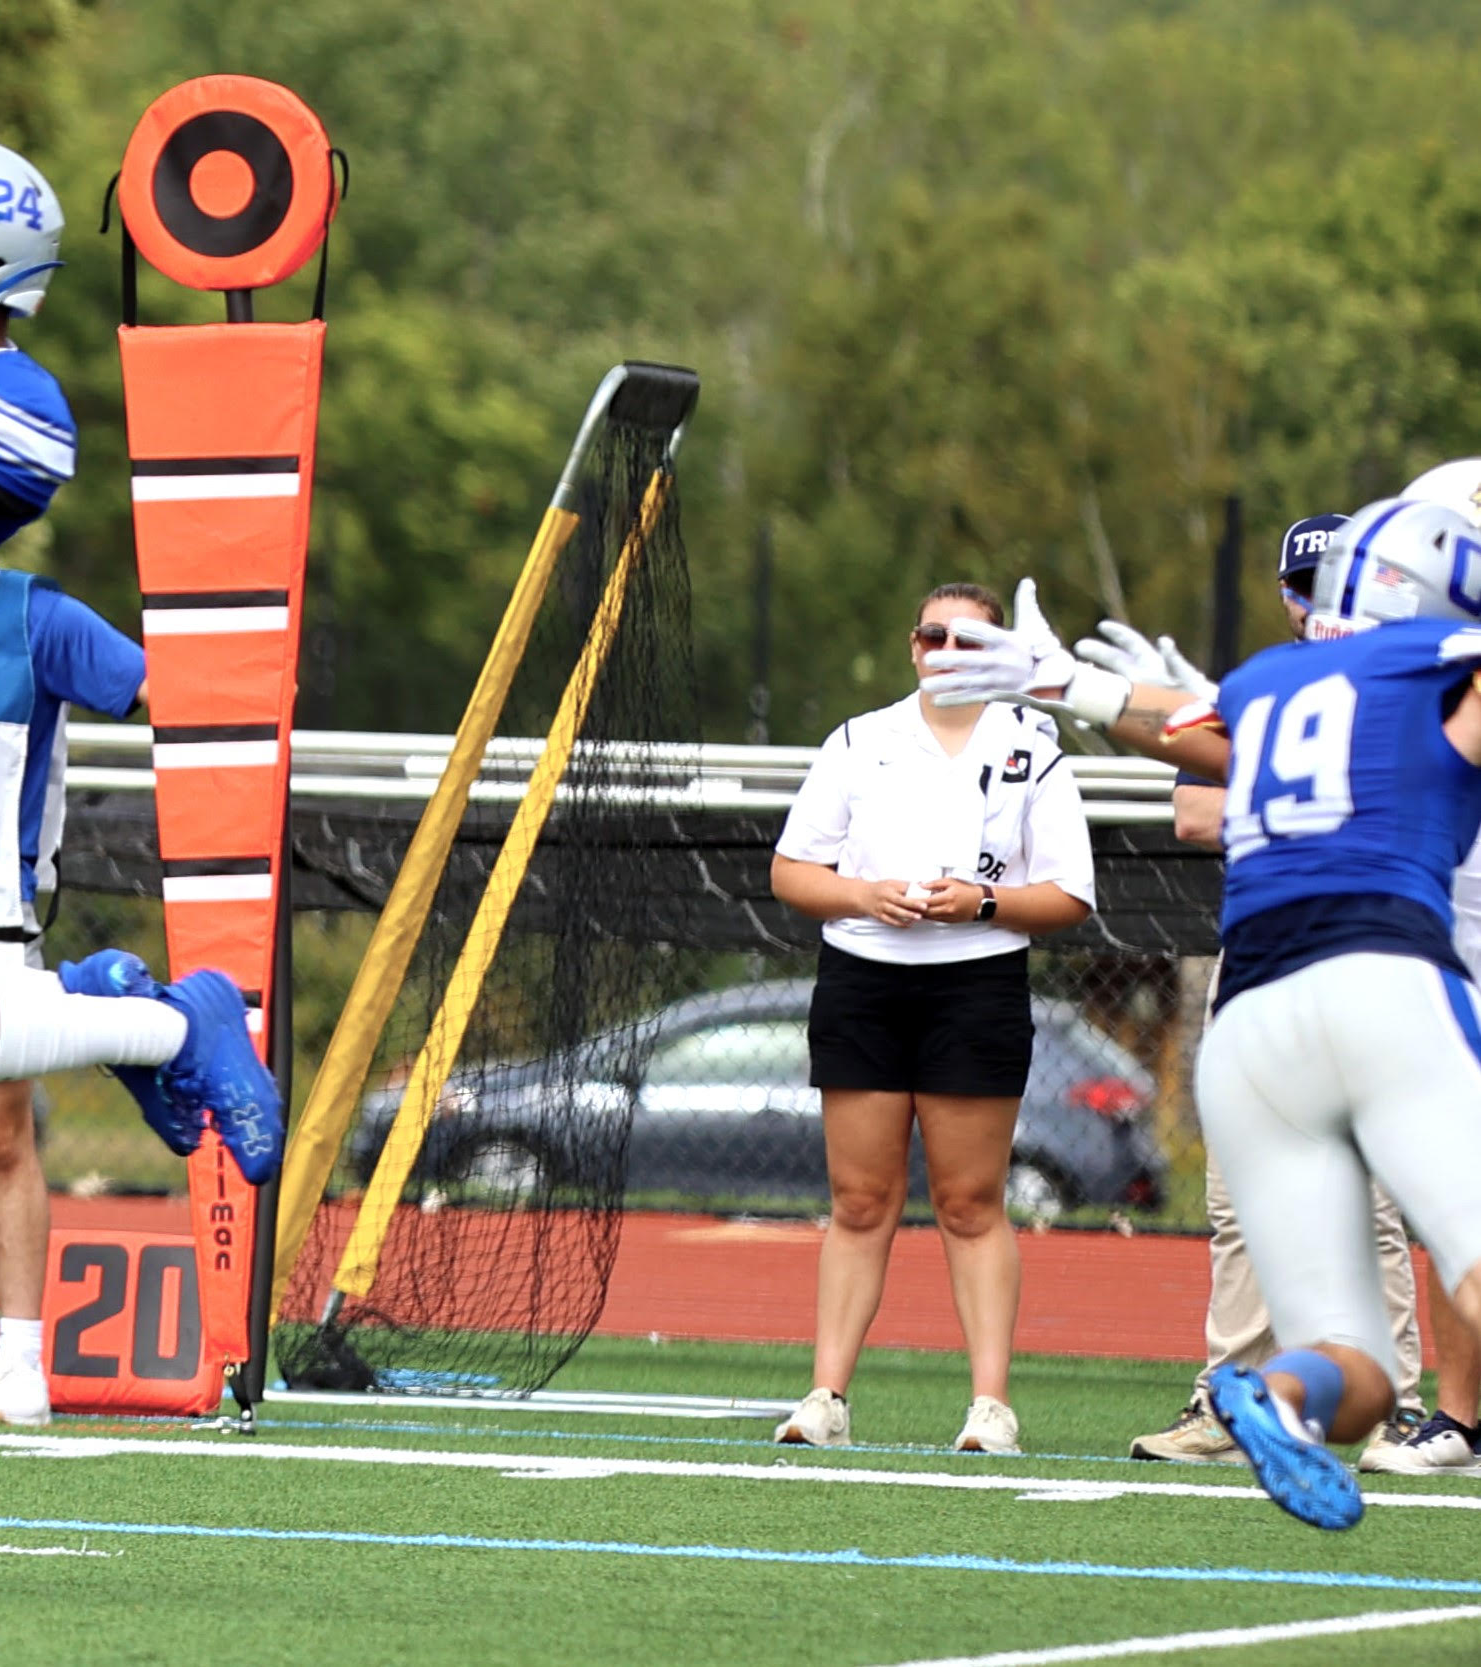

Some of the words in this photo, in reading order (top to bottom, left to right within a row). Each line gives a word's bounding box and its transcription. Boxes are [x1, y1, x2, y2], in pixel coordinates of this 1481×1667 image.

[1224, 672, 1358, 863] 19
[210, 1137, 235, 1271] ilman
[51, 1243, 202, 1381] 20
